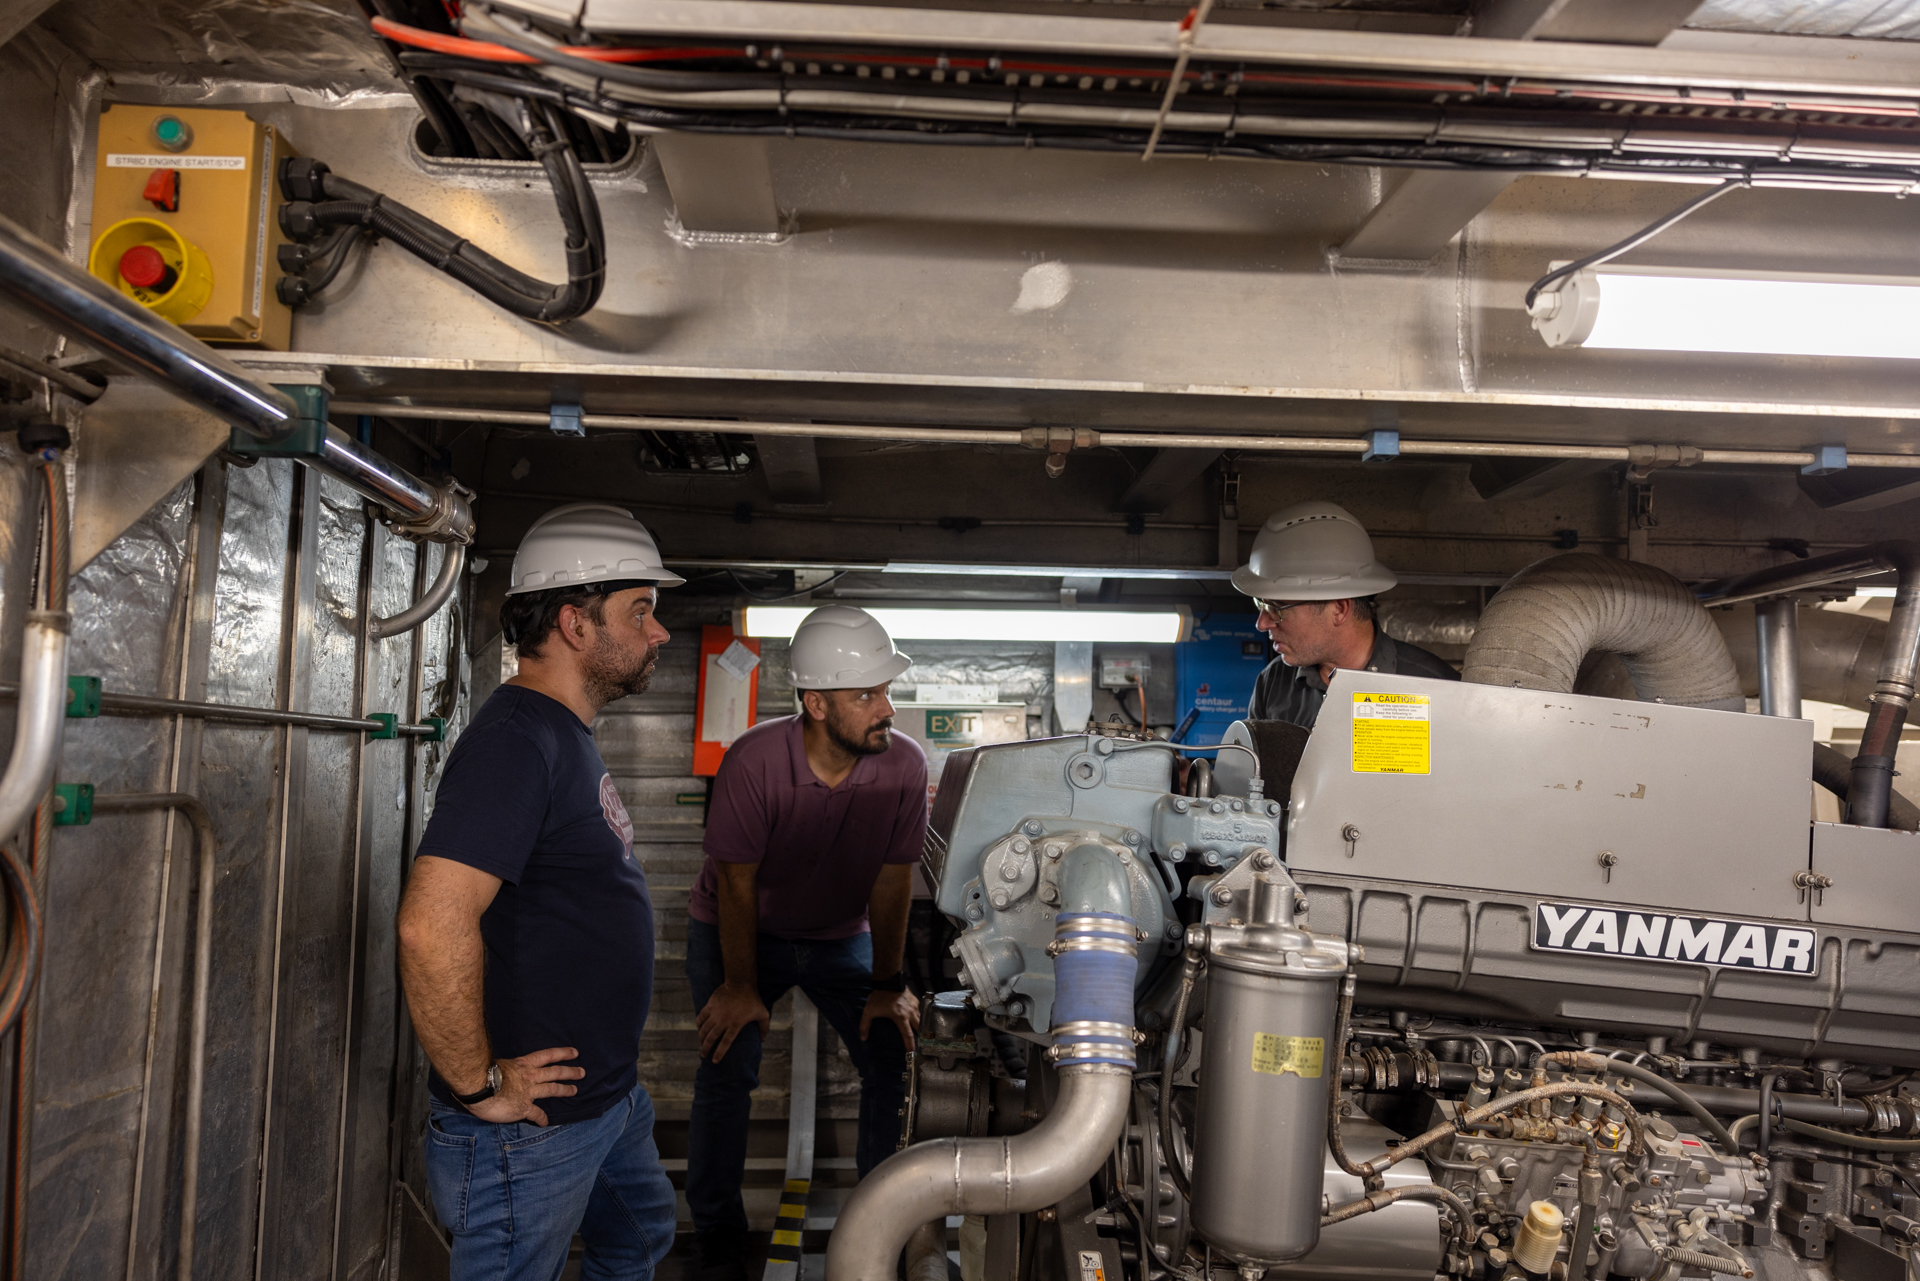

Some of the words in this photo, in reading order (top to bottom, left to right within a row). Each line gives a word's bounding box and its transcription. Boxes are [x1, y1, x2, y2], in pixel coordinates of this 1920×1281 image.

[114, 156, 146, 166] STRBD
[148, 157, 183, 166] ENGINE
[1194, 697, 1233, 706] centaur
[932, 716, 976, 732] EXIT
[1233, 822, 1242, 833] 5
[1538, 904, 1814, 972] YANMAR
